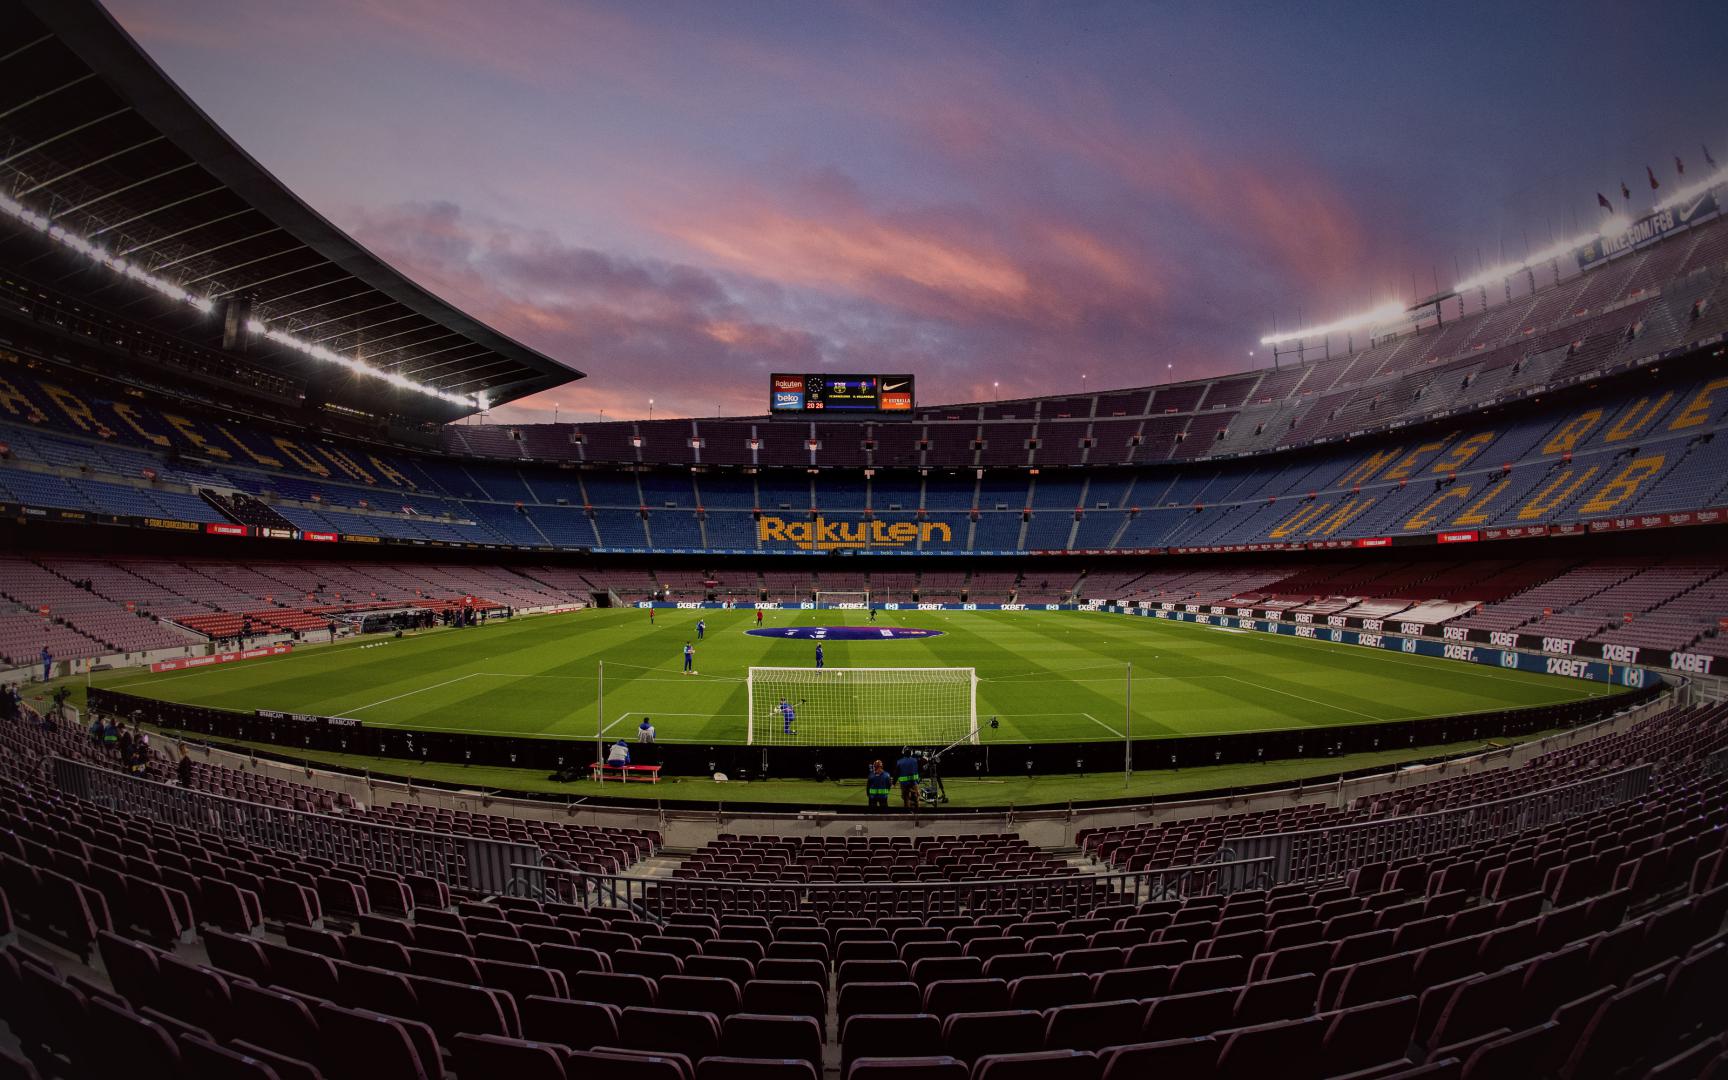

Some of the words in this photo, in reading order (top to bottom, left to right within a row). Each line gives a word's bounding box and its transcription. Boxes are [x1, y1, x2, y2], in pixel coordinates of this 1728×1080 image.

[775, 380, 802, 388] Rakuten
[777, 394, 799, 402] beko
[1541, 378, 1728, 455] QUE
[1268, 498, 1376, 538] UN
[1403, 455, 1665, 530] CLUB
[759, 515, 953, 549] Rakuten
[1328, 615, 1347, 626] 1XBET
[1363, 619, 1384, 631] 1XBET
[1401, 622, 1425, 636] 1XBET
[1443, 627, 1469, 641] 1XBET
[1490, 632, 1519, 648] 1XBET
[1542, 637, 1576, 655] 1XBET
[1602, 643, 1640, 664] 1XBET
[1670, 652, 1714, 674] 1XBET
